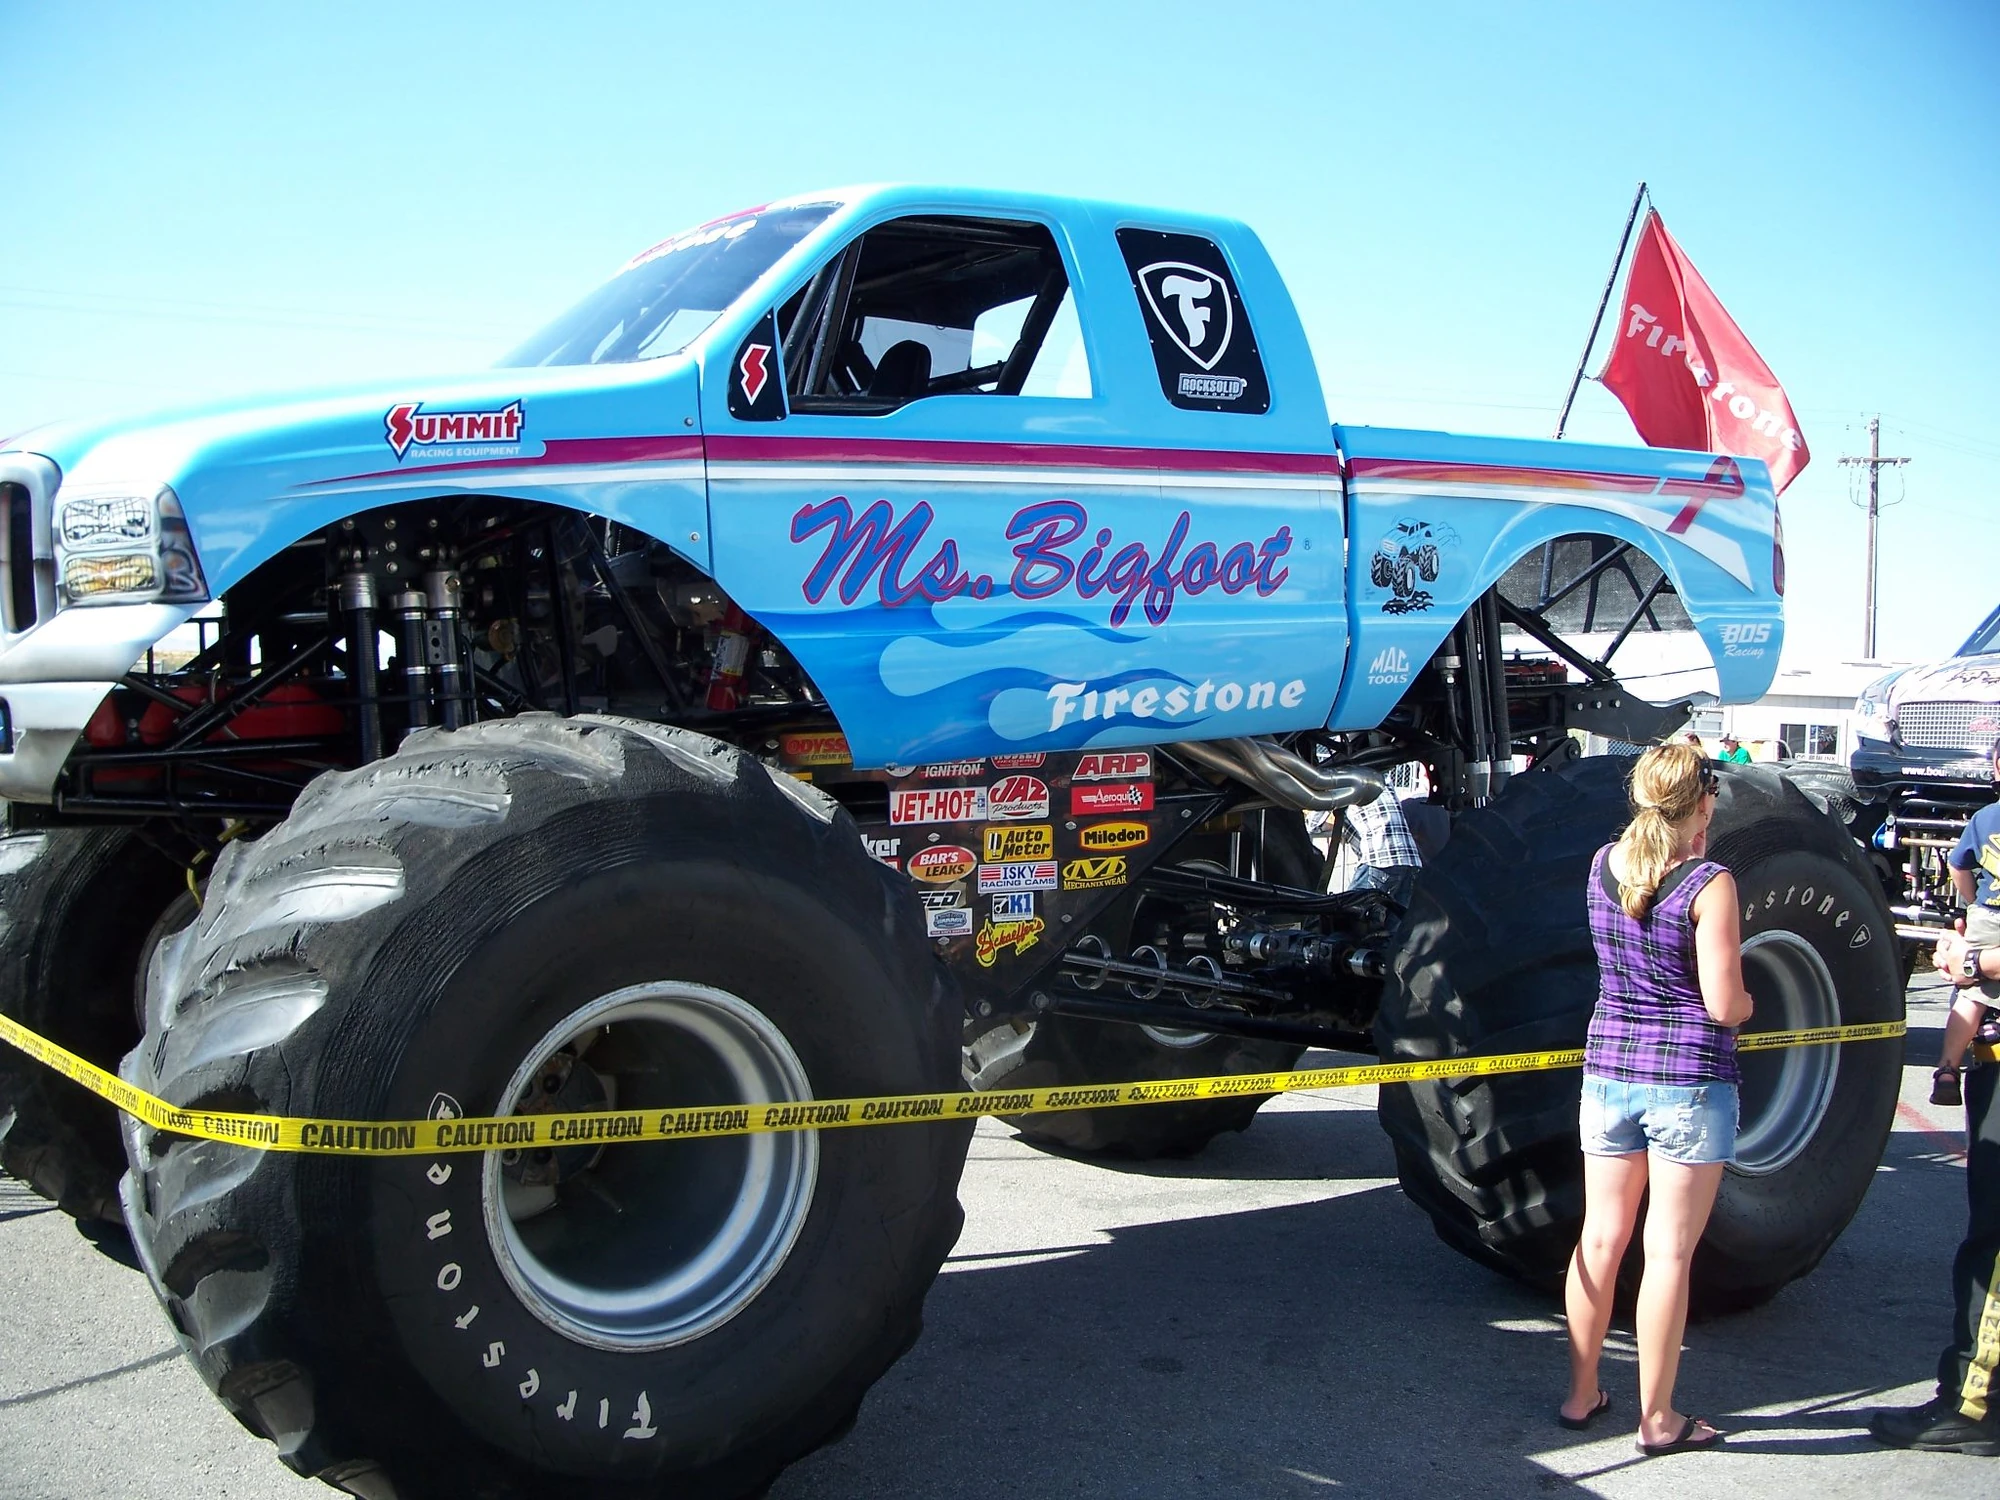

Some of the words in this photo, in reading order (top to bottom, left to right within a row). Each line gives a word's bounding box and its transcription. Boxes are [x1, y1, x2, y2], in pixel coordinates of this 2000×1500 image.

[1182, 378, 1240, 394] ROCKSOLID
[411, 447, 453, 458] RACING
[456, 446, 521, 457] EQUIPMENT
[790, 496, 992, 608] Ms.
[1005, 499, 1293, 629] Bigfoot
[1718, 623, 1772, 644] BDS
[1723, 644, 1766, 658] Racing
[1369, 646, 1409, 674] MAC
[1367, 674, 1408, 685] TOOLS
[1047, 678, 1306, 732] Firestone
[786, 737, 849, 755] ODYSS
[925, 763, 981, 778] IGNITION
[1076, 754, 1149, 776] ARP
[990, 776, 1048, 803] JAZ
[1094, 788, 1134, 804] Aeroquip
[892, 789, 976, 824] JET-HOT
[992, 801, 1045, 815] Products
[1005, 830, 1043, 844] Auto
[1084, 828, 1146, 845] Milodon
[1003, 842, 1051, 857] Meter
[919, 851, 959, 866] BAR'S
[925, 864, 965, 877] LEAKS
[1003, 866, 1036, 880] ISKY
[981, 880, 1021, 888] RACING
[1024, 877, 1056, 886] CAMS
[1063, 880, 1104, 891] MECHANIX
[1104, 874, 1127, 887] WEAR
[1009, 893, 1032, 914] K1
[1744, 884, 1850, 929] estone
[203, 1115, 280, 1145] CAUTION
[301, 1123, 416, 1150] CAUTION
[436, 1121, 536, 1148] CAUTION
[550, 1115, 643, 1142] CAUTION
[659, 1109, 749, 1135] CAUTION
[764, 1103, 850, 1127] CAUTION
[861, 1098, 944, 1121] CAUTION
[956, 1093, 1034, 1114] CAUTION
[1045, 1088, 1120, 1107] CAUTION
[1128, 1082, 1199, 1101] CAUTION
[1208, 1076, 1277, 1094] CAUTION
[1285, 1070, 1349, 1088] CAUTION
[1355, 1065, 1415, 1082] CAUTION
[1423, 1061, 1479, 1076] CAUTION
[1486, 1055, 1540, 1070] CAUTION
